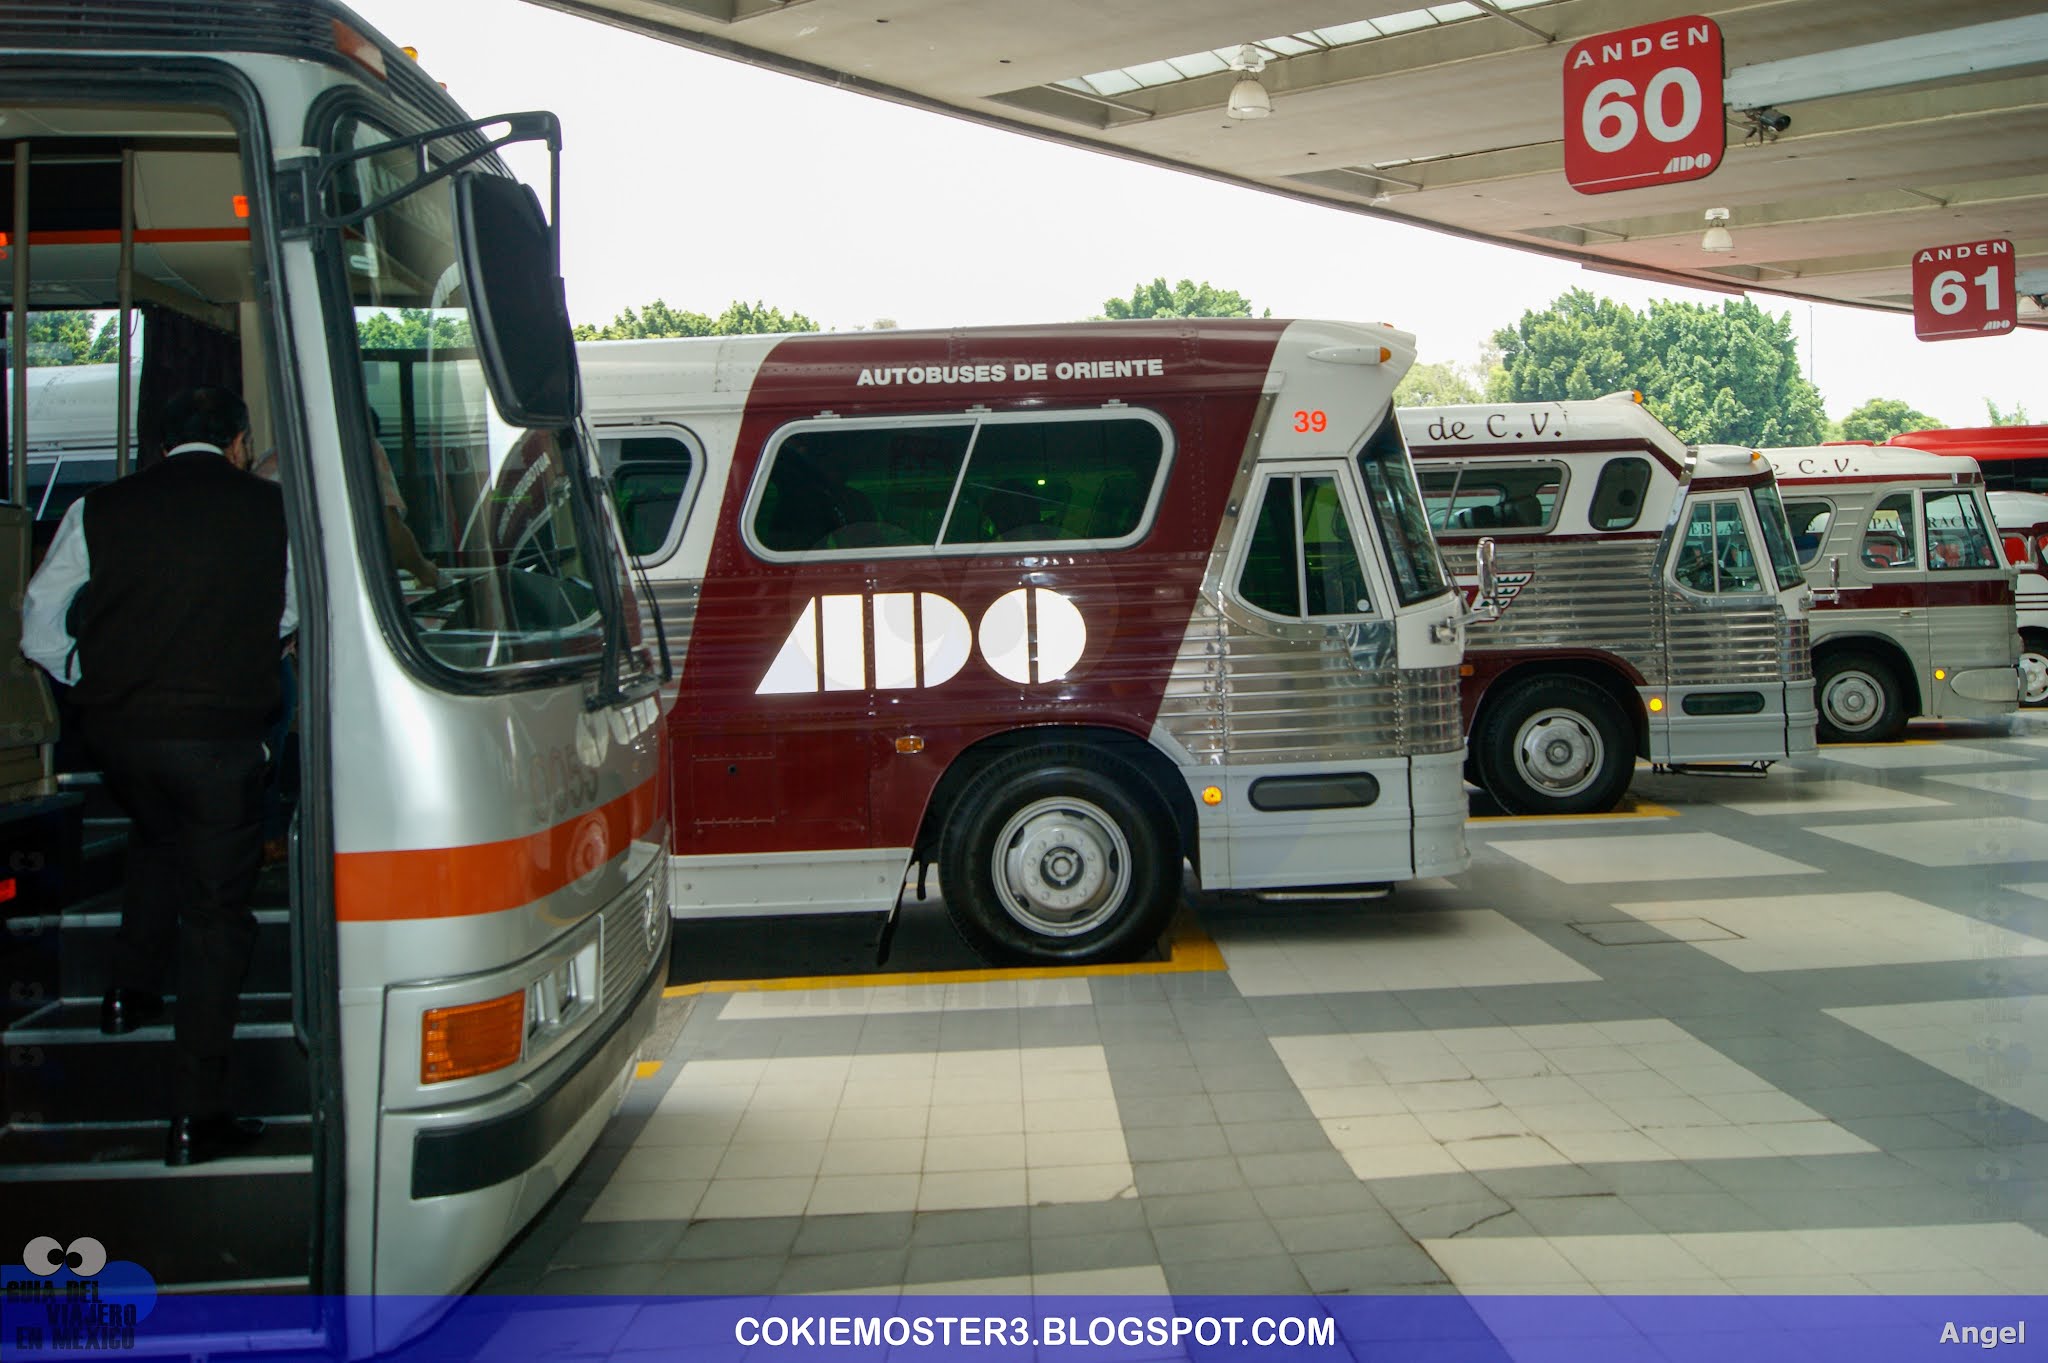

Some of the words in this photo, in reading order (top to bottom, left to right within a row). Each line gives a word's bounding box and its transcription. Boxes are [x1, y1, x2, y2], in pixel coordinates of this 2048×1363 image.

[1573, 24, 1709, 70] ANDEN
[1582, 66, 1702, 153] 60
[1663, 152, 1712, 174] ADO
[1918, 241, 2007, 263] ANDEN
[1930, 265, 2000, 315] 61
[1983, 319, 2011, 331] ADO
[856, 365, 1006, 386] AUTOBUSES
[1013, 363, 1048, 381] DE
[1055, 359, 1164, 380] ORIENTE
[1293, 411, 1327, 434] 39
[1428, 416, 1474, 441] de
[755, 588, 1087, 695] ADO
